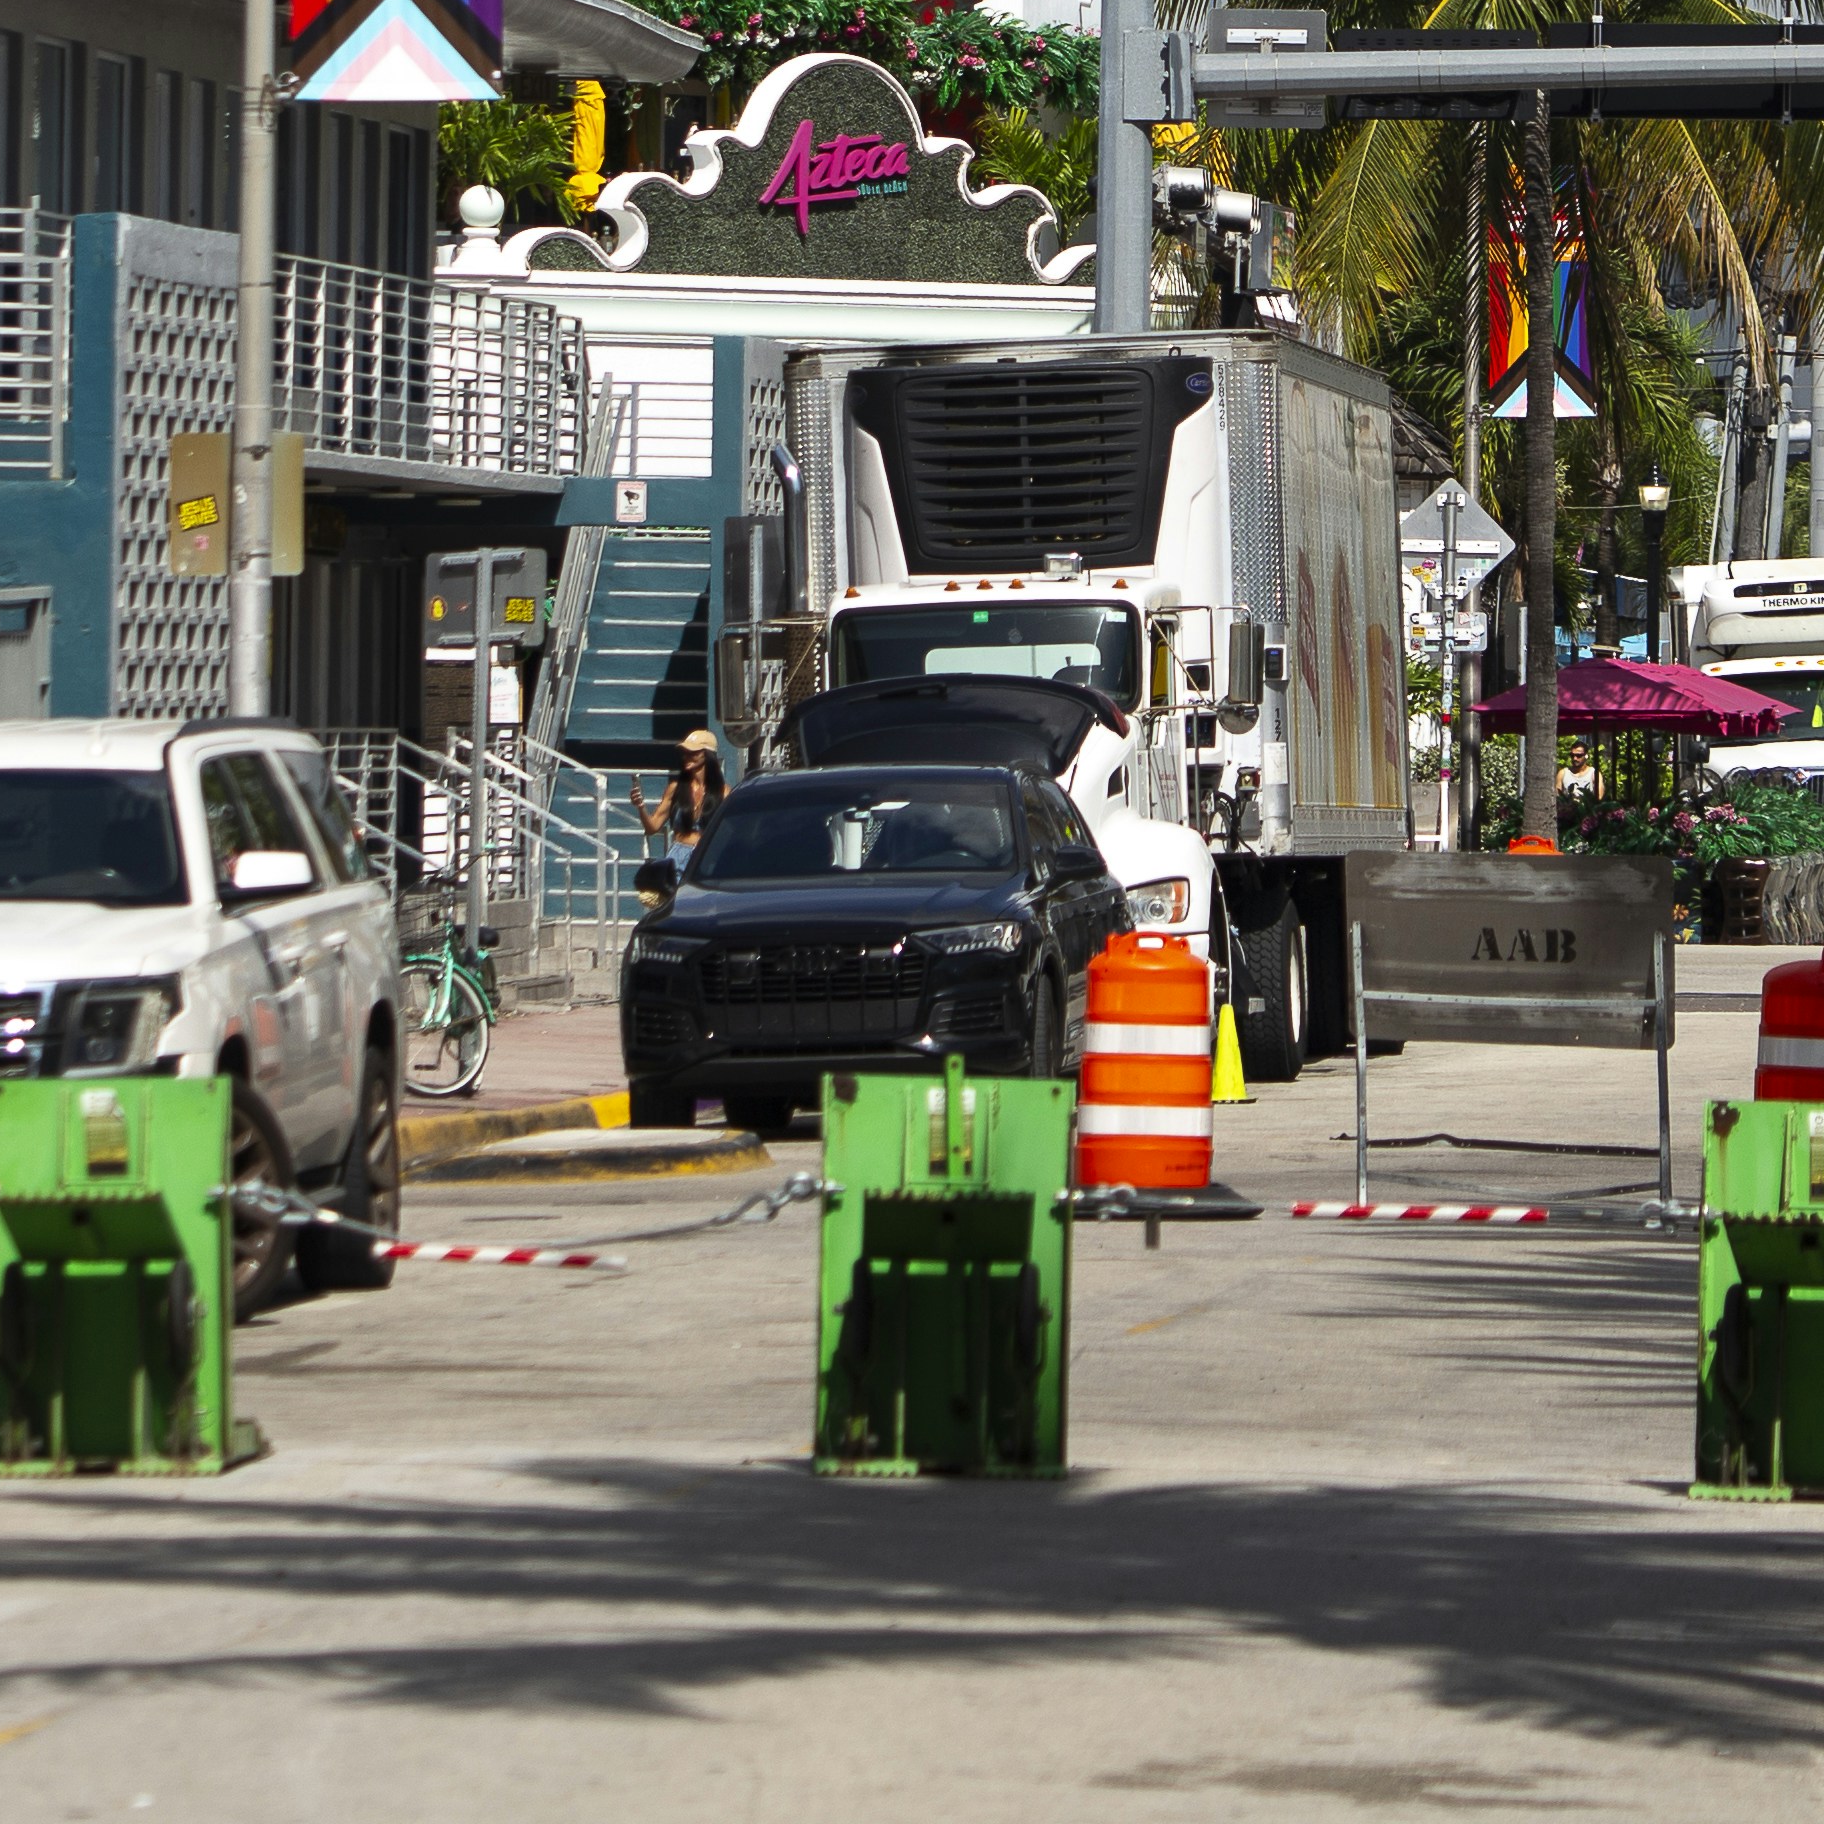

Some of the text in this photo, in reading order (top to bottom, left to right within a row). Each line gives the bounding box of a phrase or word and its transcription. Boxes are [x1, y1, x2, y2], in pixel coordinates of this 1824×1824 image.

[758, 118, 911, 235] Azteca
[1217, 364, 1226, 431] 528429
[1762, 597, 1807, 608] THERMO
[1471, 927, 1577, 963] AAB
